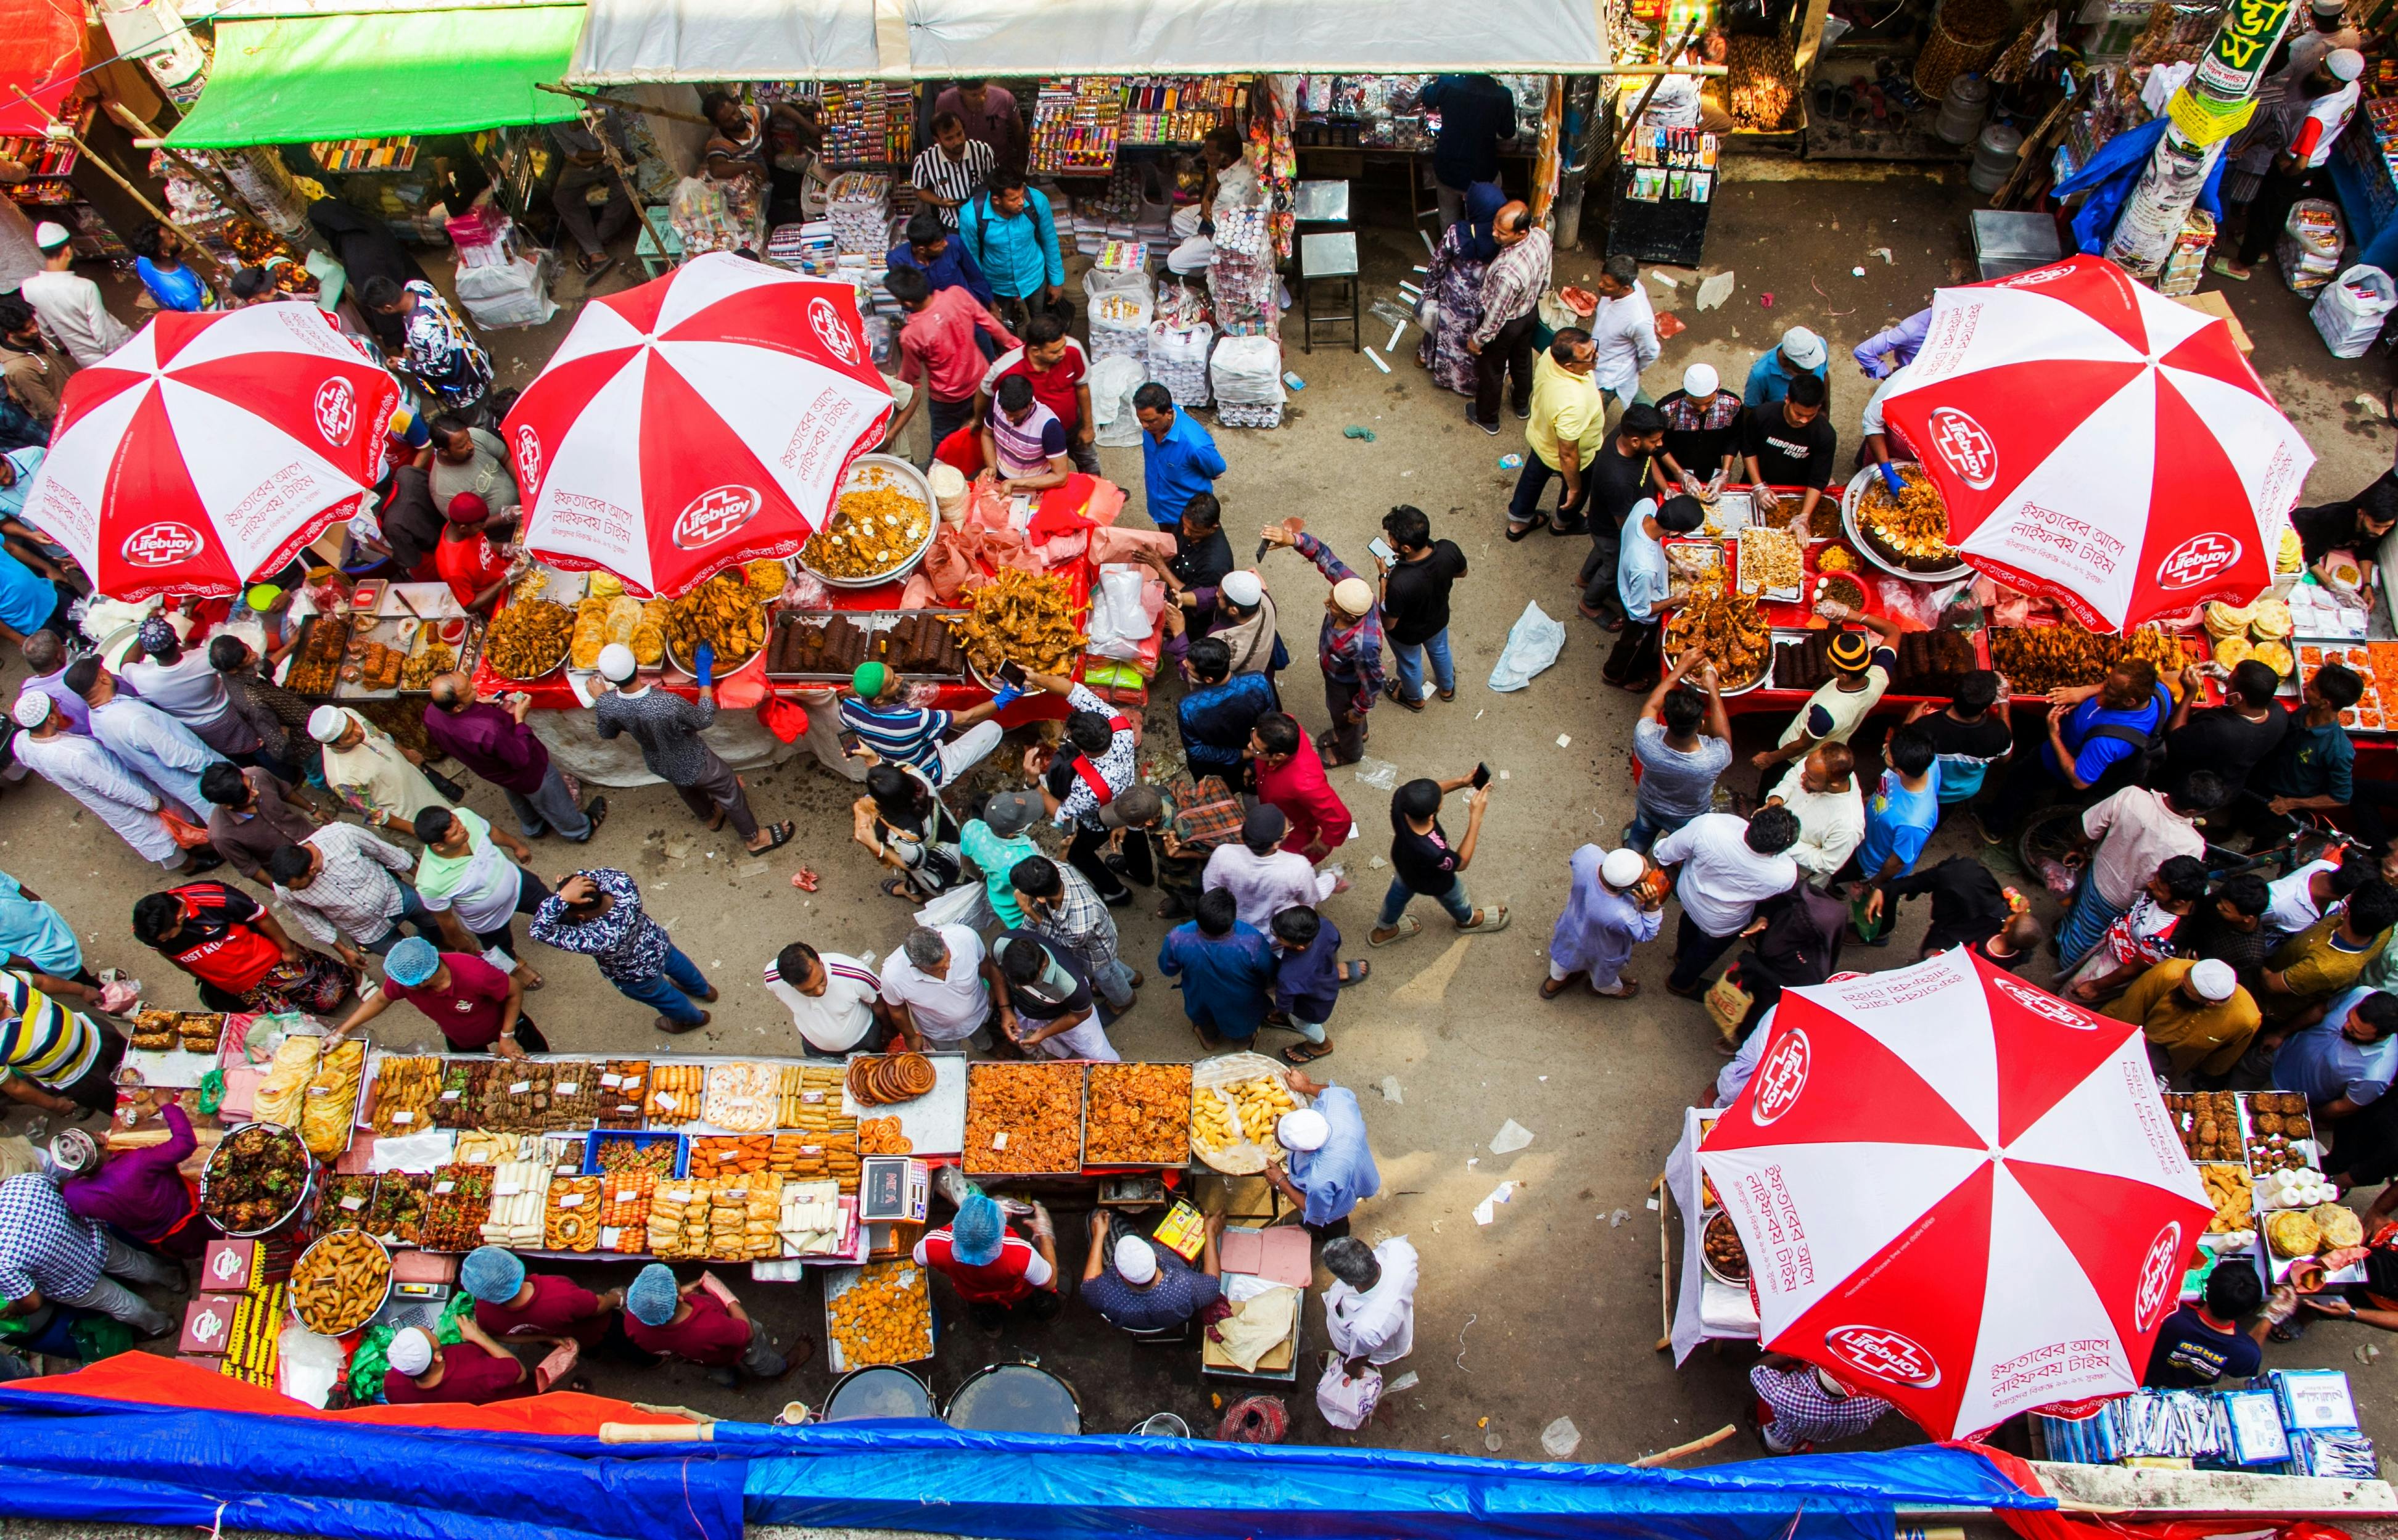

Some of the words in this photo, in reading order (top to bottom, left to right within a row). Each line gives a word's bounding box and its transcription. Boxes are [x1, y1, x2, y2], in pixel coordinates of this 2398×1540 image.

[822, 306, 848, 357] Lifebuoy
[324, 385, 348, 438] Lifebuoy
[780, 411, 817, 469] ইফতারের
[810, 386, 838, 412] আগে
[521, 430, 535, 484] Lifebuoy
[797, 425, 830, 481] লাইফবয়
[822, 397, 852, 427] টাইম
[1766, 436, 1808, 453] MIDORIYA
[1943, 415, 1984, 478] Lifebuoy
[224, 480, 275, 527] ইফতারের
[271, 461, 303, 482] আগে
[237, 495, 284, 541] লাইফবয়
[281, 475, 315, 499] টাইম
[554, 489, 606, 514] ইফতারের
[608, 504, 633, 525] আগে
[682, 500, 750, 535] Lifebuoy
[131, 537, 194, 553] Lifebuoy
[553, 509, 601, 532] লাইফবয়
[604, 519, 631, 544] টাইম
[2011, 522, 2079, 553] লাইফবয়
[2080, 543, 2116, 575] টাইম
[2021, 501, 2091, 537] ইফতারের
[2092, 527, 2126, 556] আগে
[2166, 551, 2231, 574] Lifebuoy
[2006, 986, 2085, 1026] Lifebuoy
[1762, 1040, 1802, 1114] Lifebuoy
[885, 1172, 897, 1204] MEGA
[1746, 1172, 1785, 1245] লাইফবয়
[1776, 1247, 1797, 1292] টাইম
[1765, 1164, 1805, 1241] ইফতারের
[1797, 1243, 1814, 1285] আগে
[2139, 1235, 2173, 1318] Lifebuoy
[1840, 1332, 1927, 1378] Lifebuoy
[1991, 1343, 2066, 1380] ইফতারের
[2069, 1339, 2110, 1351] আগে
[1991, 1362, 2062, 1397] লাইফবয়
[2069, 1354, 2110, 1372] টাইম
